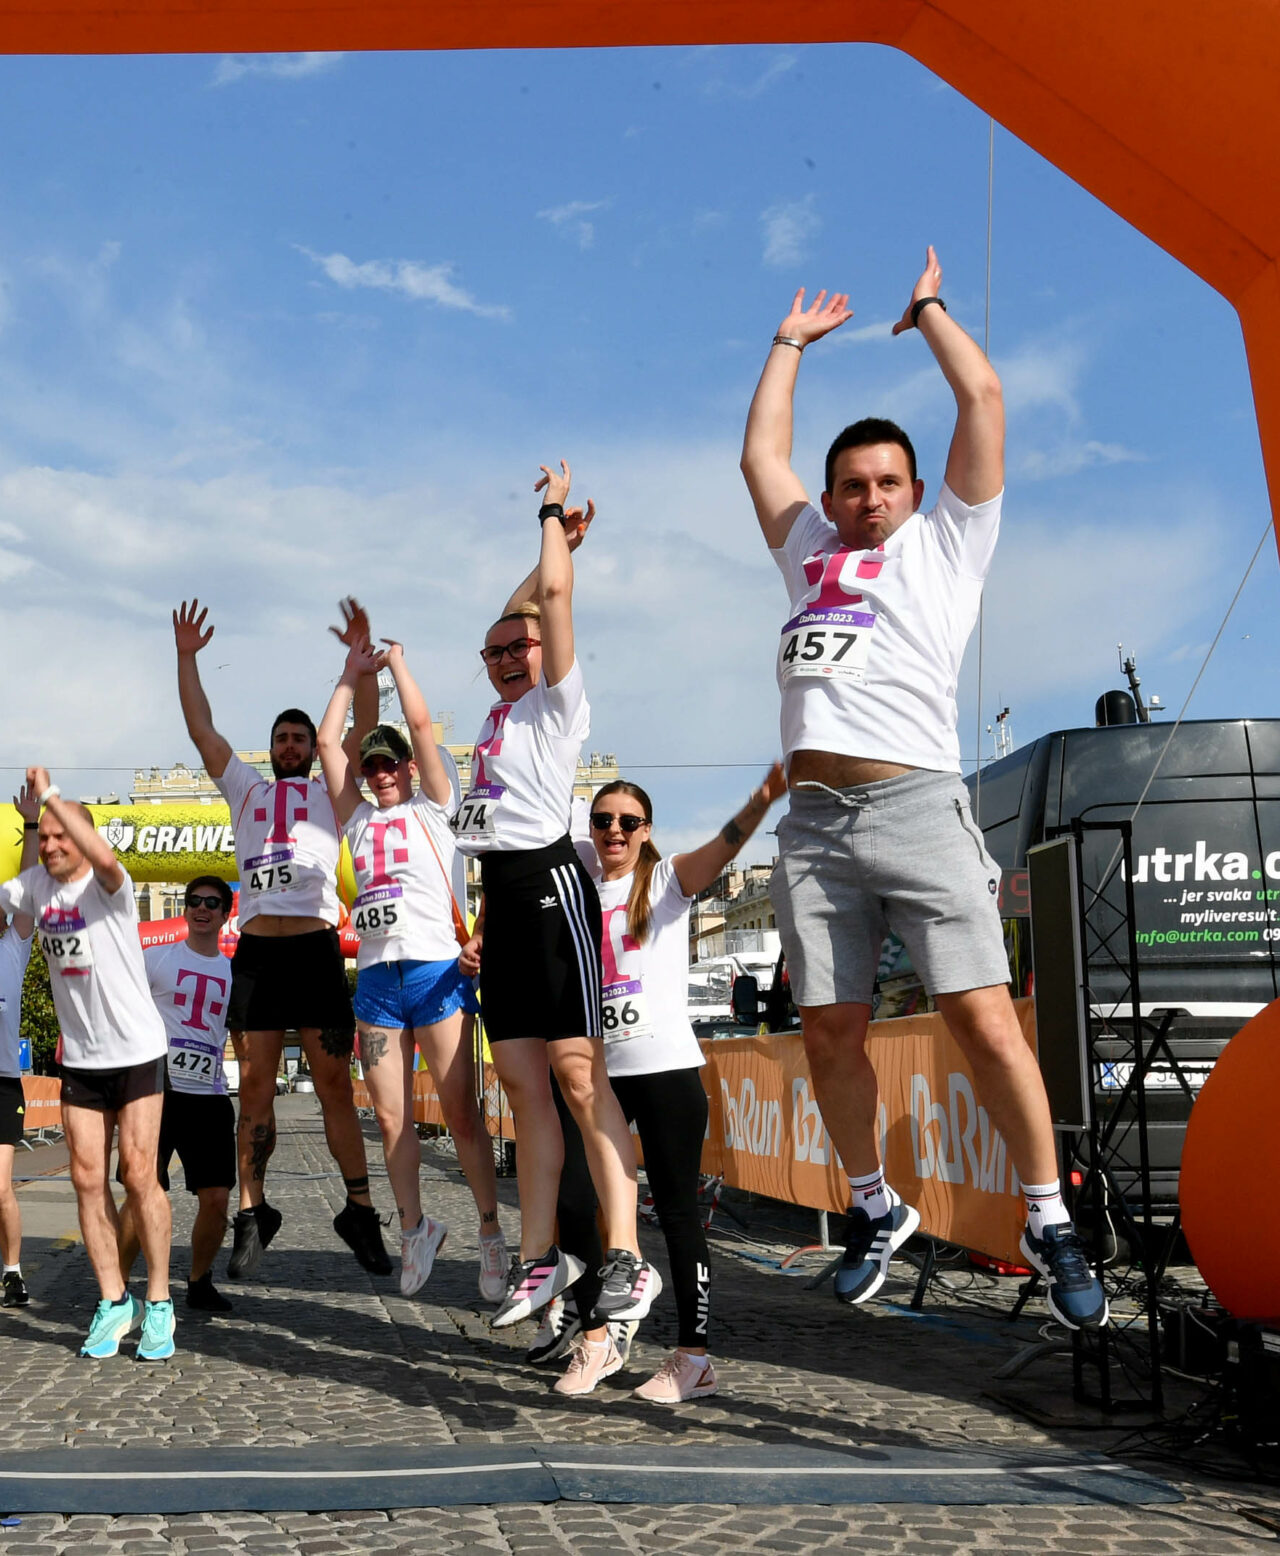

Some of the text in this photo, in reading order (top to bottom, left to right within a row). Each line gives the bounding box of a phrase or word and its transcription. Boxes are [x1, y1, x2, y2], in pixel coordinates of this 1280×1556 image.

[826, 612, 855, 623] 2023.
[782, 631, 858, 664] 457
[449, 804, 487, 831] 474
[136, 824, 236, 853] GRAWE
[249, 864, 293, 891] 475
[1179, 889, 1204, 905] jer
[1206, 888, 1252, 902] svaka
[355, 903, 398, 932] 485
[42, 936, 83, 958] 482
[1135, 929, 1259, 946] info@utrka.com
[173, 968, 227, 1031] T
[609, 986, 629, 997] 2023.
[602, 1001, 640, 1031] 86
[173, 1052, 212, 1075] 472
[696, 1262, 710, 1335] NIKE
